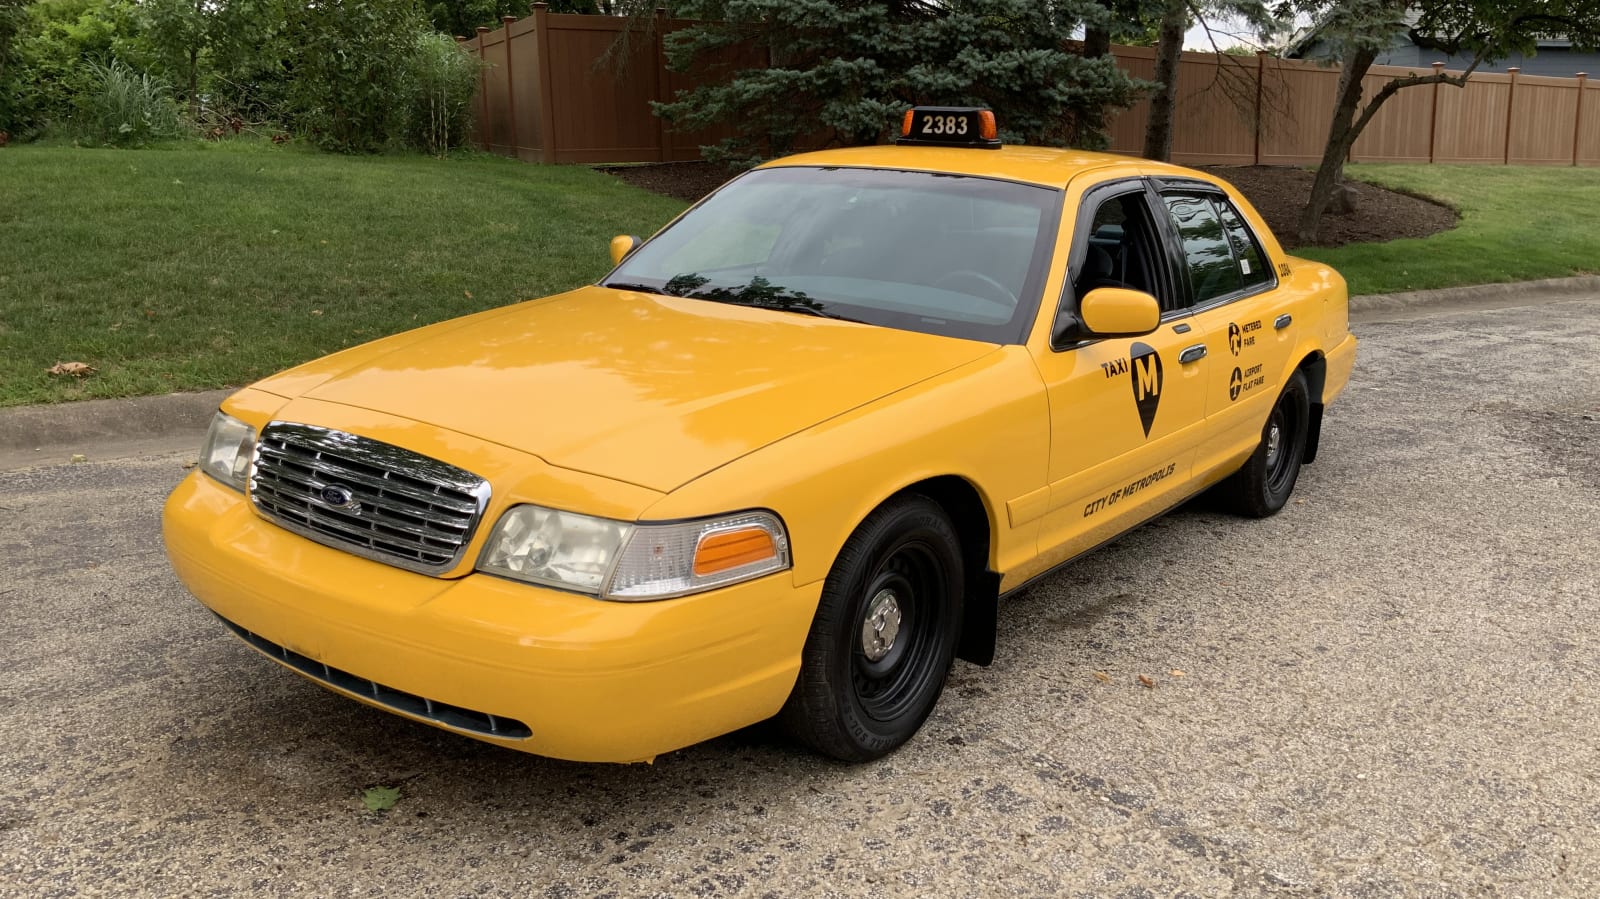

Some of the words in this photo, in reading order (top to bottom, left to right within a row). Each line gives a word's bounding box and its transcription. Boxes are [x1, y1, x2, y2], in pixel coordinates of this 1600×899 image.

[922, 115, 968, 135] 2383
[1242, 320, 1262, 334] METERED
[1244, 336, 1255, 347] FARE
[1101, 357, 1129, 379] TAXI
[1244, 363, 1263, 378] AIRPORT
[1135, 354, 1158, 402] M
[1243, 379, 1254, 392] FLAT
[1254, 376, 1265, 387] FARE
[1083, 496, 1109, 518] CITY
[1108, 489, 1122, 506] OF
[1122, 462, 1176, 499] METROPOLIS
